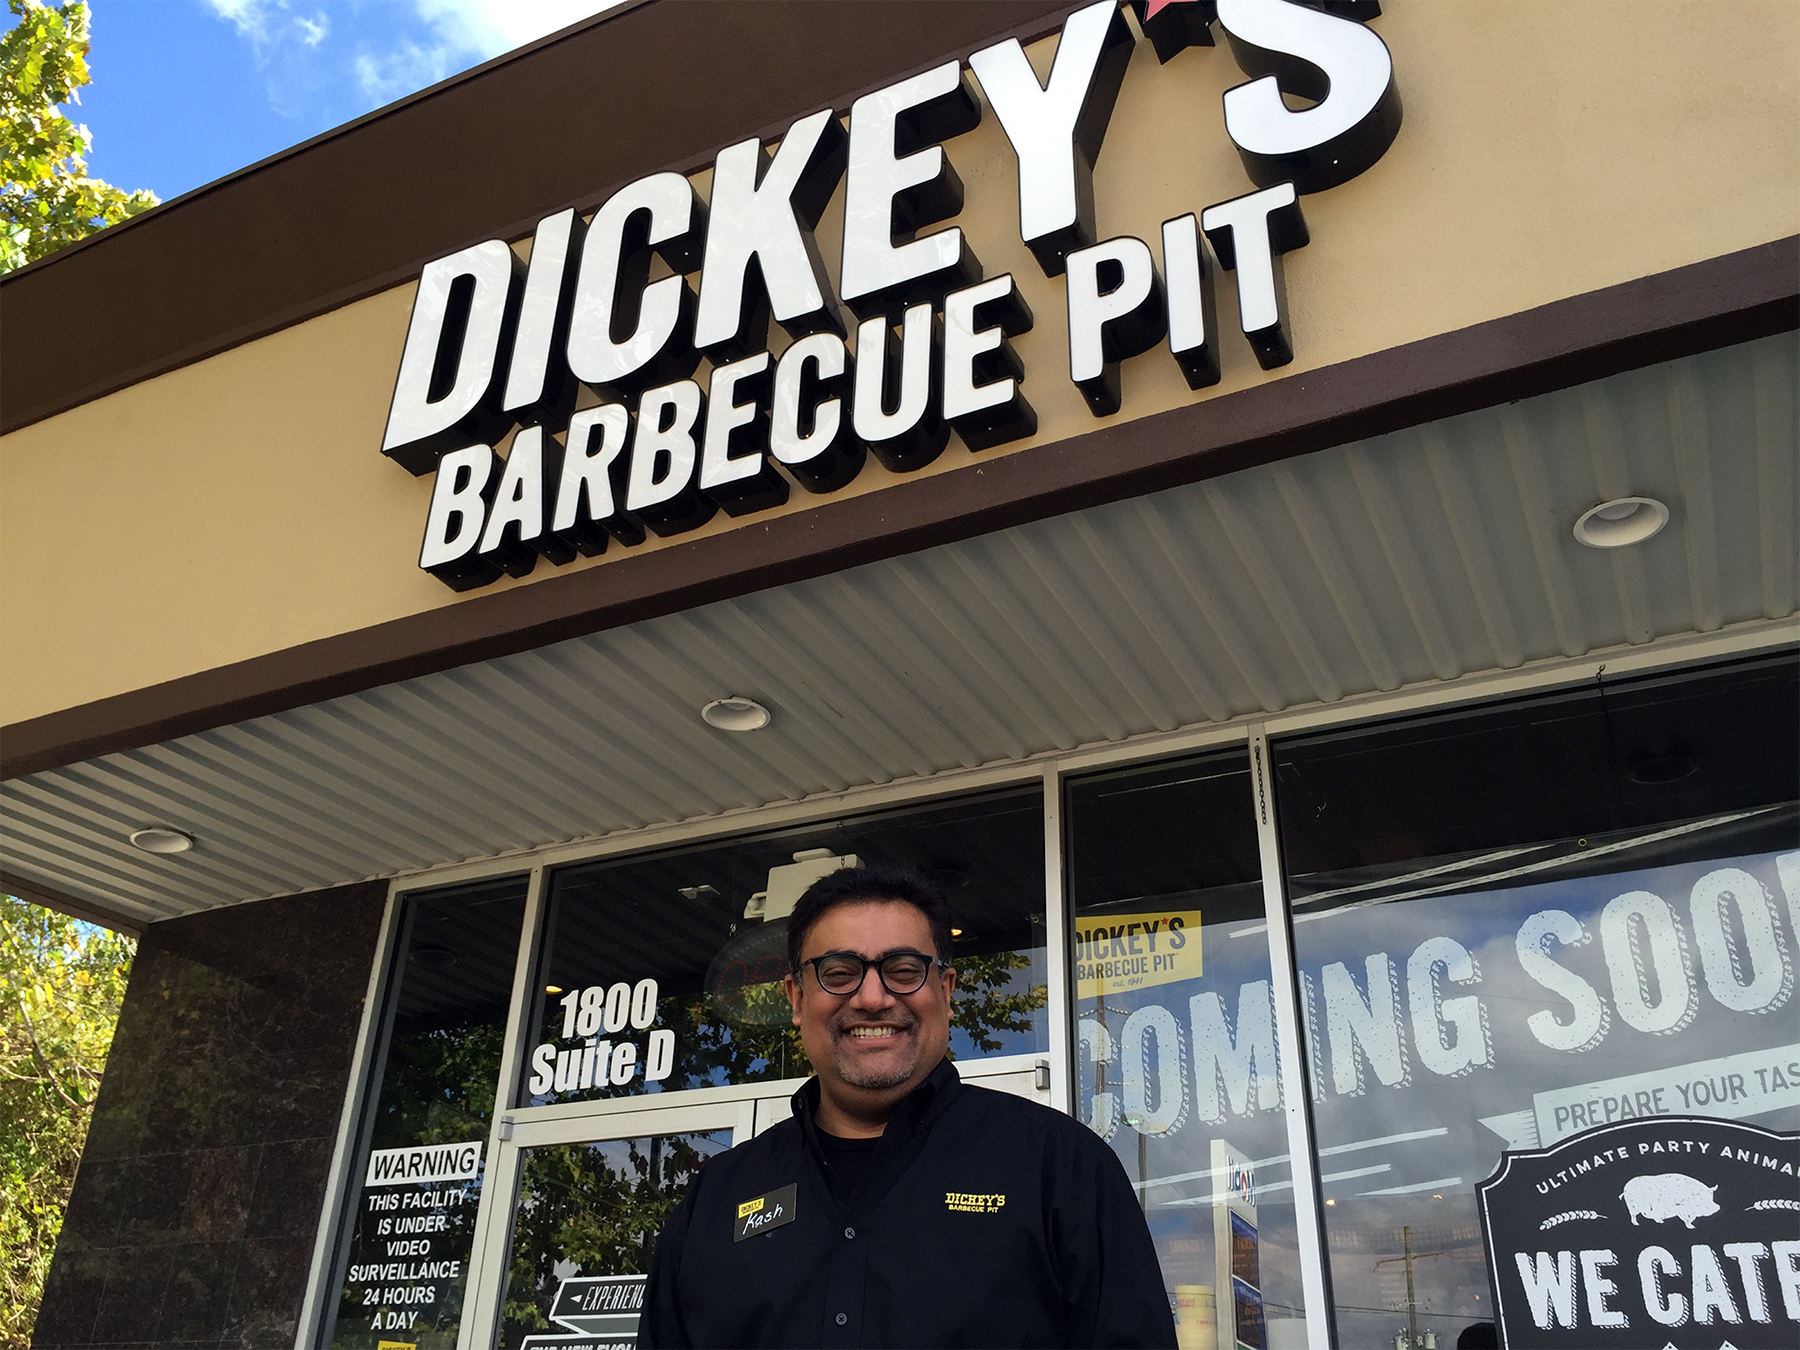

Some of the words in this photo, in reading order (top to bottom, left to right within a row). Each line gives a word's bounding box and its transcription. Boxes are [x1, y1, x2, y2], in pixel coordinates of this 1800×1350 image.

[418, 273, 1016, 569] BARBECUE
[1066, 181, 1296, 383] PIT
[1077, 957, 1149, 981] BARBECUE
[1153, 953, 1176, 972] PIT
[1127, 976, 1144, 987] 1941
[560, 978, 659, 1039] 1800
[528, 1038, 637, 1096] Suite
[645, 1029, 676, 1082] D
[1553, 1087, 1670, 1132] PREPARE
[1675, 1073, 1748, 1109] YOUR
[373, 1147, 476, 1180] WARNING
[1535, 1146, 1630, 1195] ULTIMATE
[1637, 1139, 1710, 1155] PARTY
[1720, 1145, 1800, 1178] ANIMA
[368, 1193, 400, 1212] THIS
[402, 1188, 468, 1210] FACILITY
[948, 1204, 985, 1213] BARBECUE
[986, 1206, 999, 1214] PIT
[377, 1217, 393, 1235] IS
[394, 1215, 446, 1235] UNDER
[742, 1203, 784, 1235] Kash
[387, 1239, 431, 1257] VIDEO
[348, 1260, 461, 1282] SURVEILLANCE
[362, 1287, 381, 1305] 24
[382, 1286, 436, 1305] HOURS
[1514, 1250, 1629, 1330] WE
[370, 1311, 382, 1330] A
[385, 1311, 419, 1330] DAY
